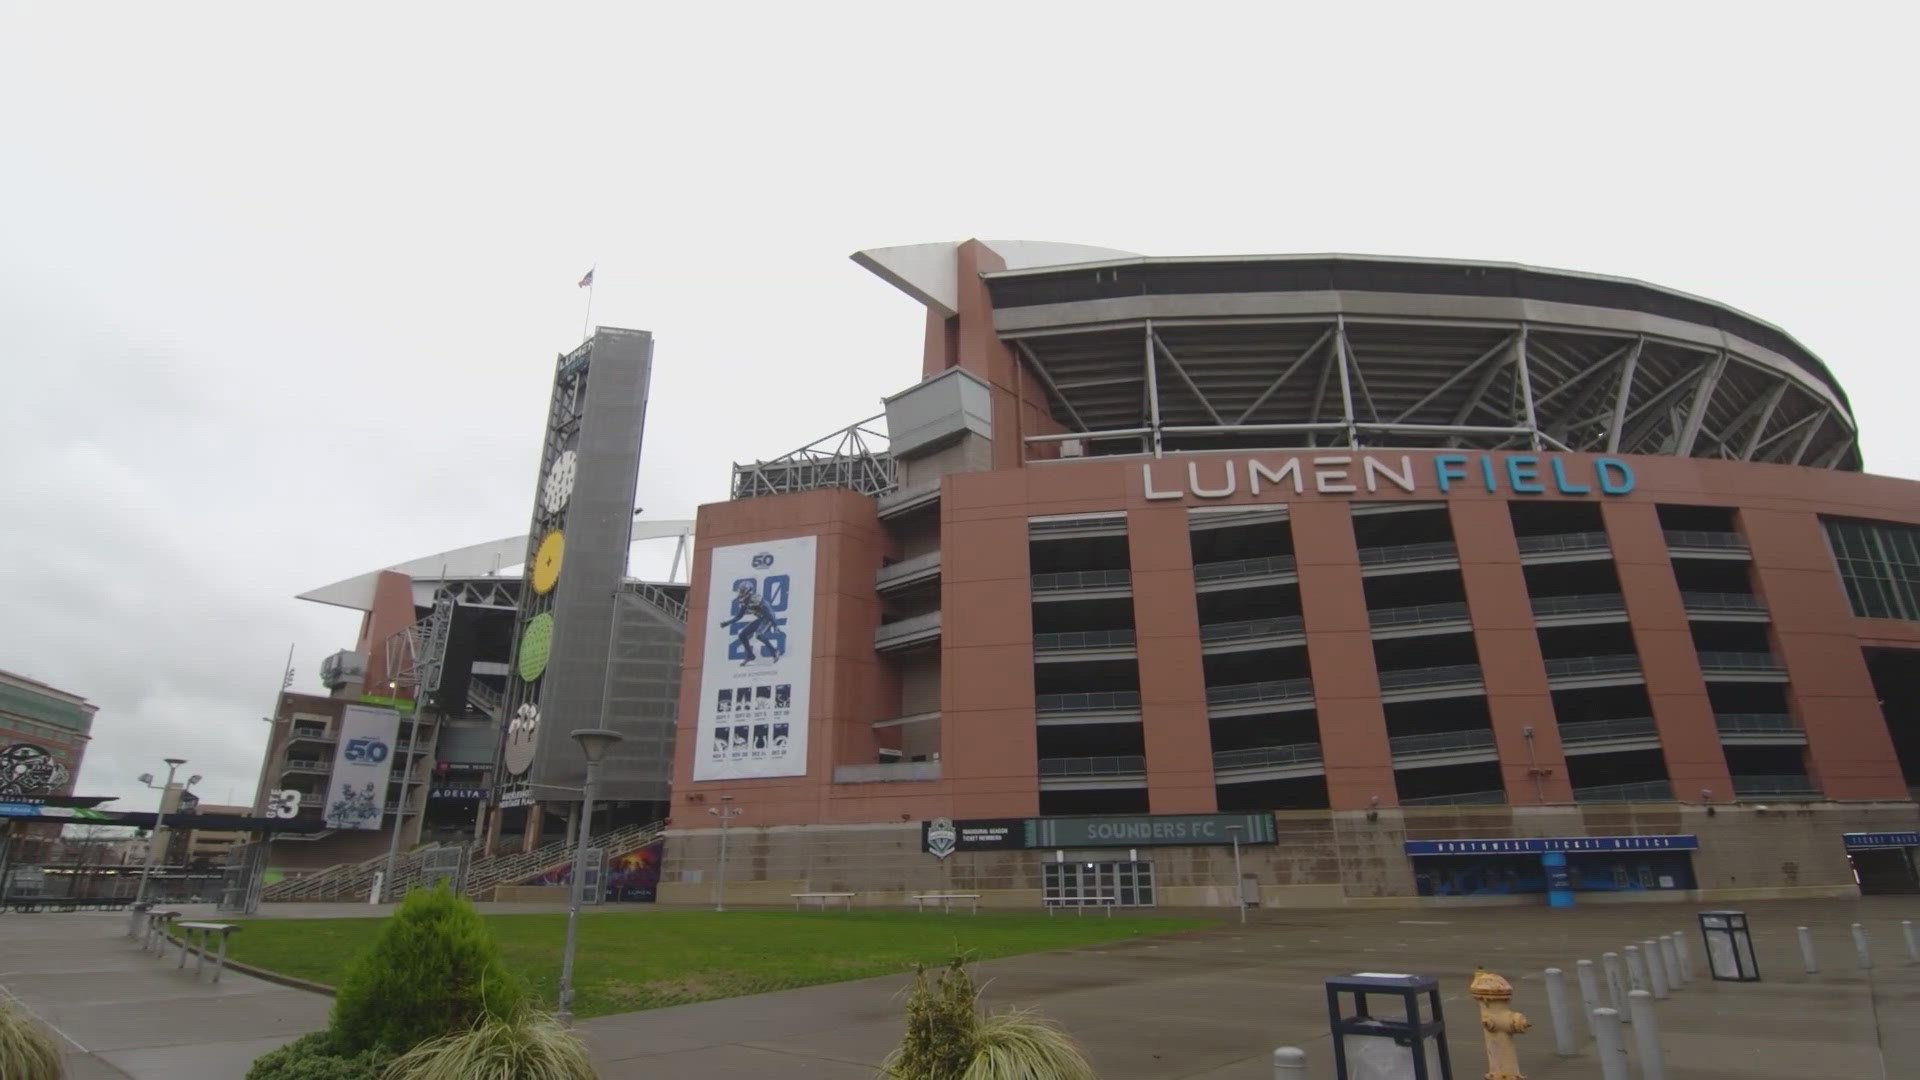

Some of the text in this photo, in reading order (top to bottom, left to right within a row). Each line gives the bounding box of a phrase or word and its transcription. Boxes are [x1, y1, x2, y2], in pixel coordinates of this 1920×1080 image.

[1143, 454, 1636, 500] LUMEN FIELD
[751, 554, 775, 568] 50
[344, 739, 388, 763] 50
[443, 789, 480, 798] DELTA
[266, 789, 281, 818] GATE
[277, 789, 302, 819] 3
[962, 834, 978, 842] TICKET
[1087, 821, 1216, 840] SOUNDERS FC
[1437, 838, 1670, 852] NORTHWEST TICKET OFFICE
